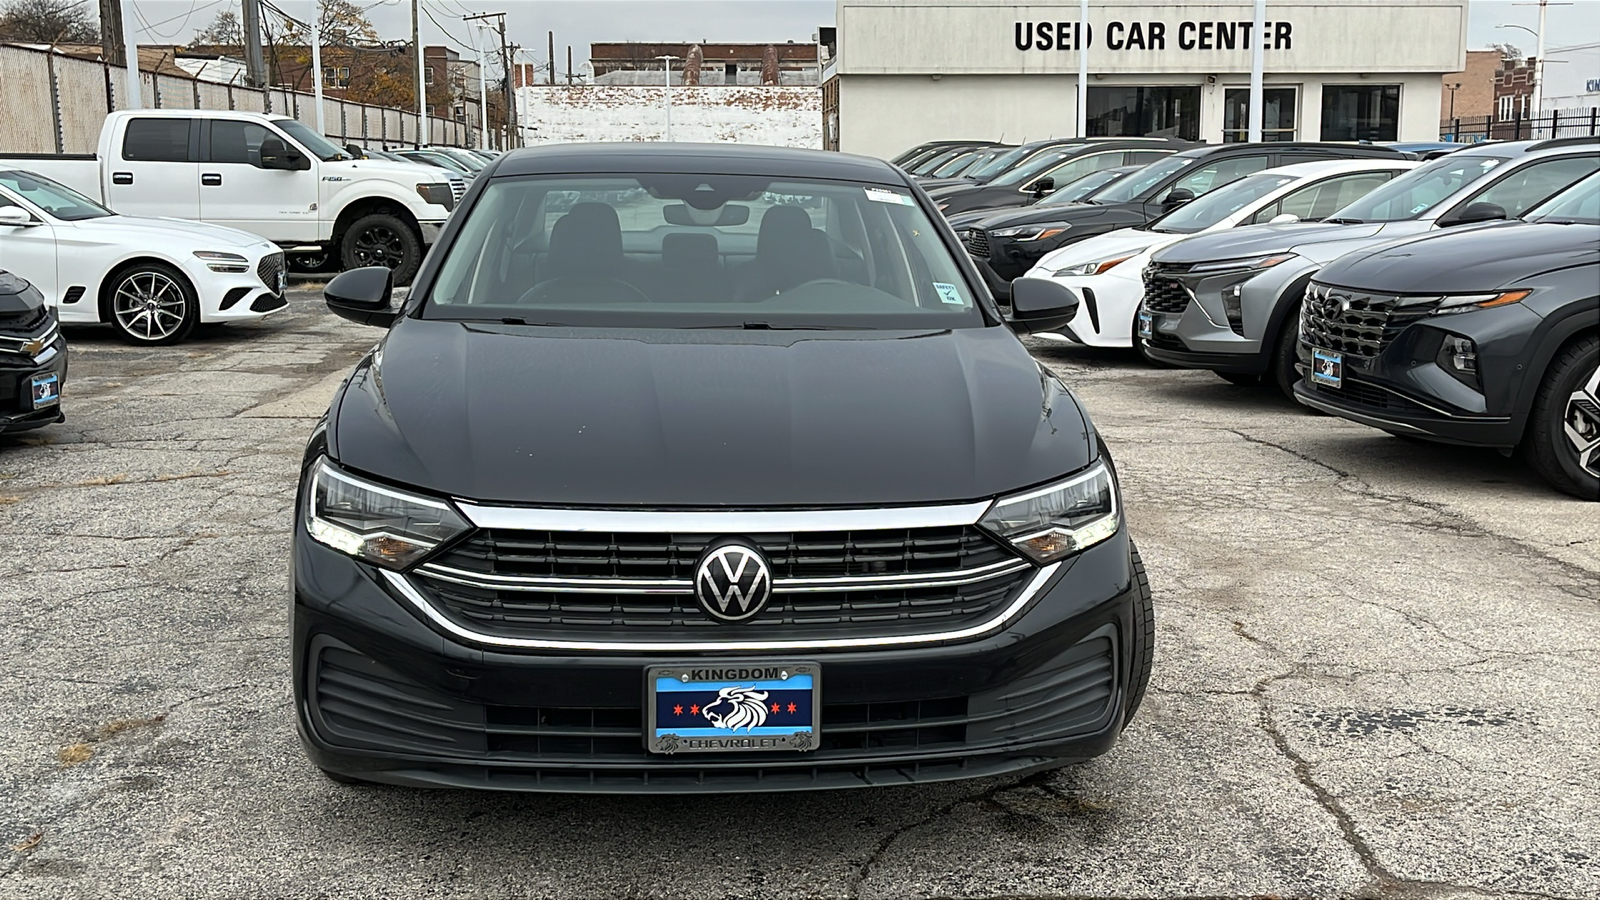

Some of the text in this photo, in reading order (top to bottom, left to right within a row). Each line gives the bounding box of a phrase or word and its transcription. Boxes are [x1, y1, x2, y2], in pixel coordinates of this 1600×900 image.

[1015, 22, 1092, 50] USED
[1106, 21, 1166, 50] CAR
[691, 667, 779, 681] KINGDOM
[689, 738, 778, 750] CHEVROLET
